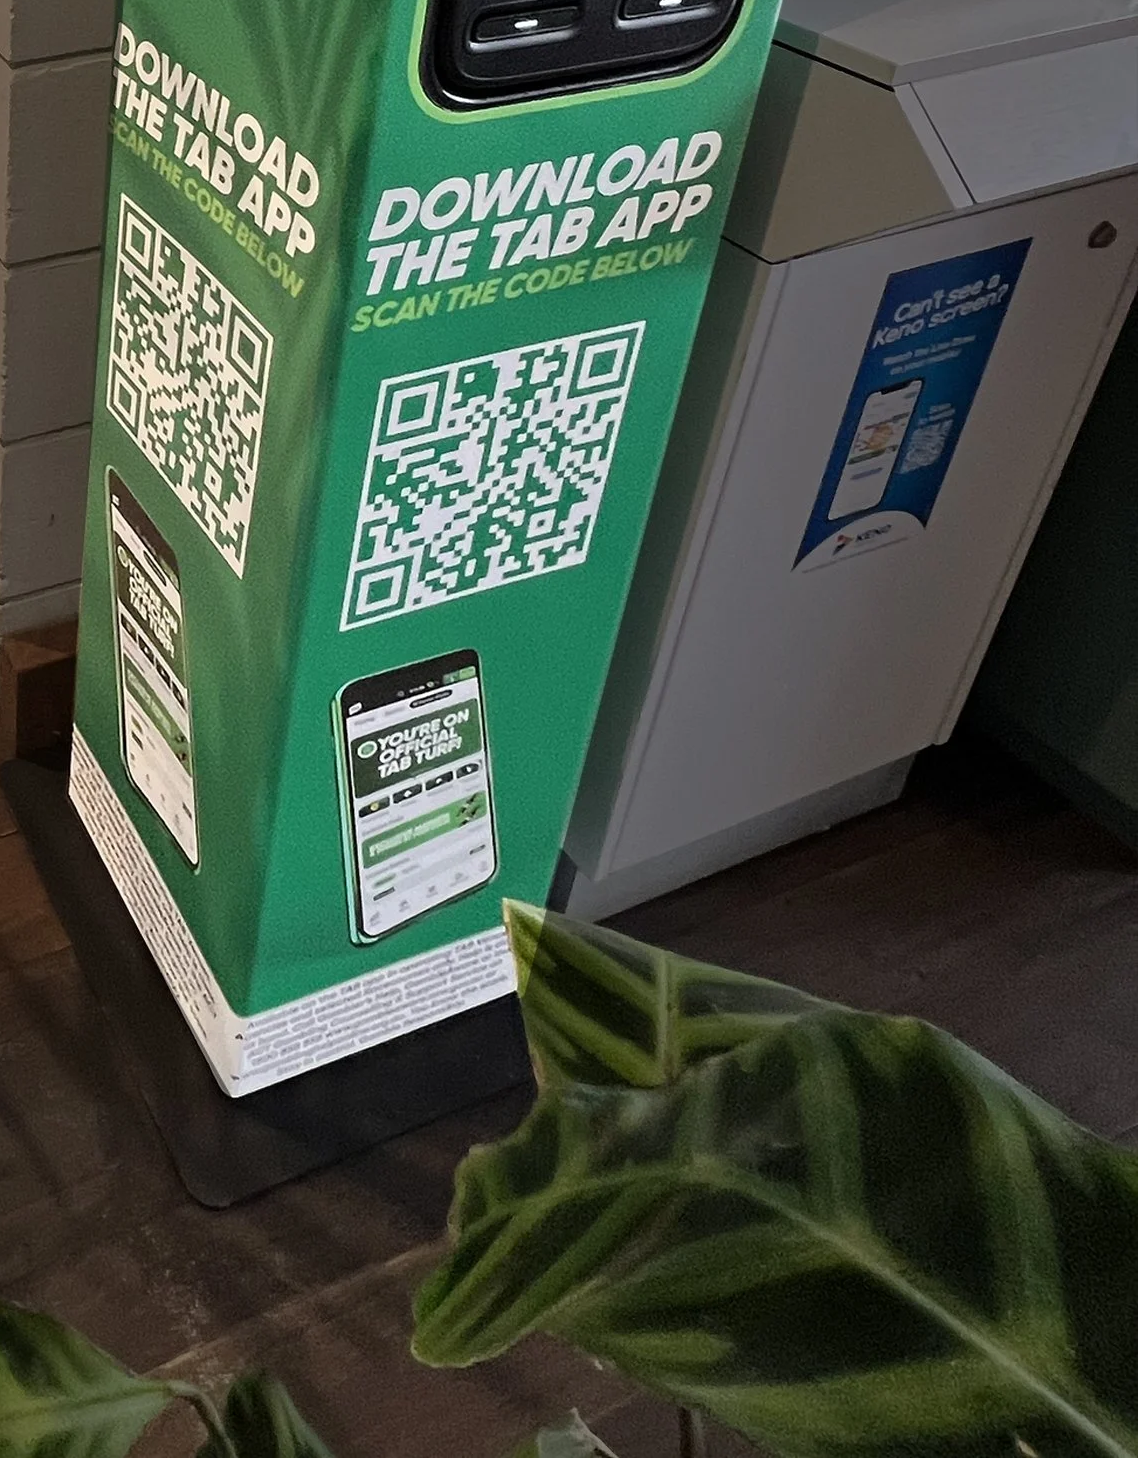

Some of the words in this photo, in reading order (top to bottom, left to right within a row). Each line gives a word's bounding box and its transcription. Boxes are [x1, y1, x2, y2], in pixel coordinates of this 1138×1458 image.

[113, 66, 167, 142] THE
[172, 112, 235, 195] TAB
[237, 175, 316, 258] APP
[114, 22, 319, 208] DOWNLOAD
[152, 147, 183, 190] THE
[184, 178, 234, 236] CODE
[235, 220, 305, 300] BELOW
[368, 131, 722, 241] DOWNLOAD
[350, 291, 443, 333] SCAN
[445, 278, 503, 313] THE
[504, 259, 591, 299] CODE
[591, 237, 696, 282] BELOW
[366, 228, 479, 296] THE
[488, 206, 595, 269] TAB
[594, 184, 712, 249] APP
[871, 319, 924, 350] Keno
[946, 280, 984, 304] see
[987, 274, 1000, 289] a
[377, 718, 441, 751] YOU'RE
[443, 708, 469, 728] ON
[377, 755, 412, 779] TAB
[379, 727, 458, 764] OFFICIAL
